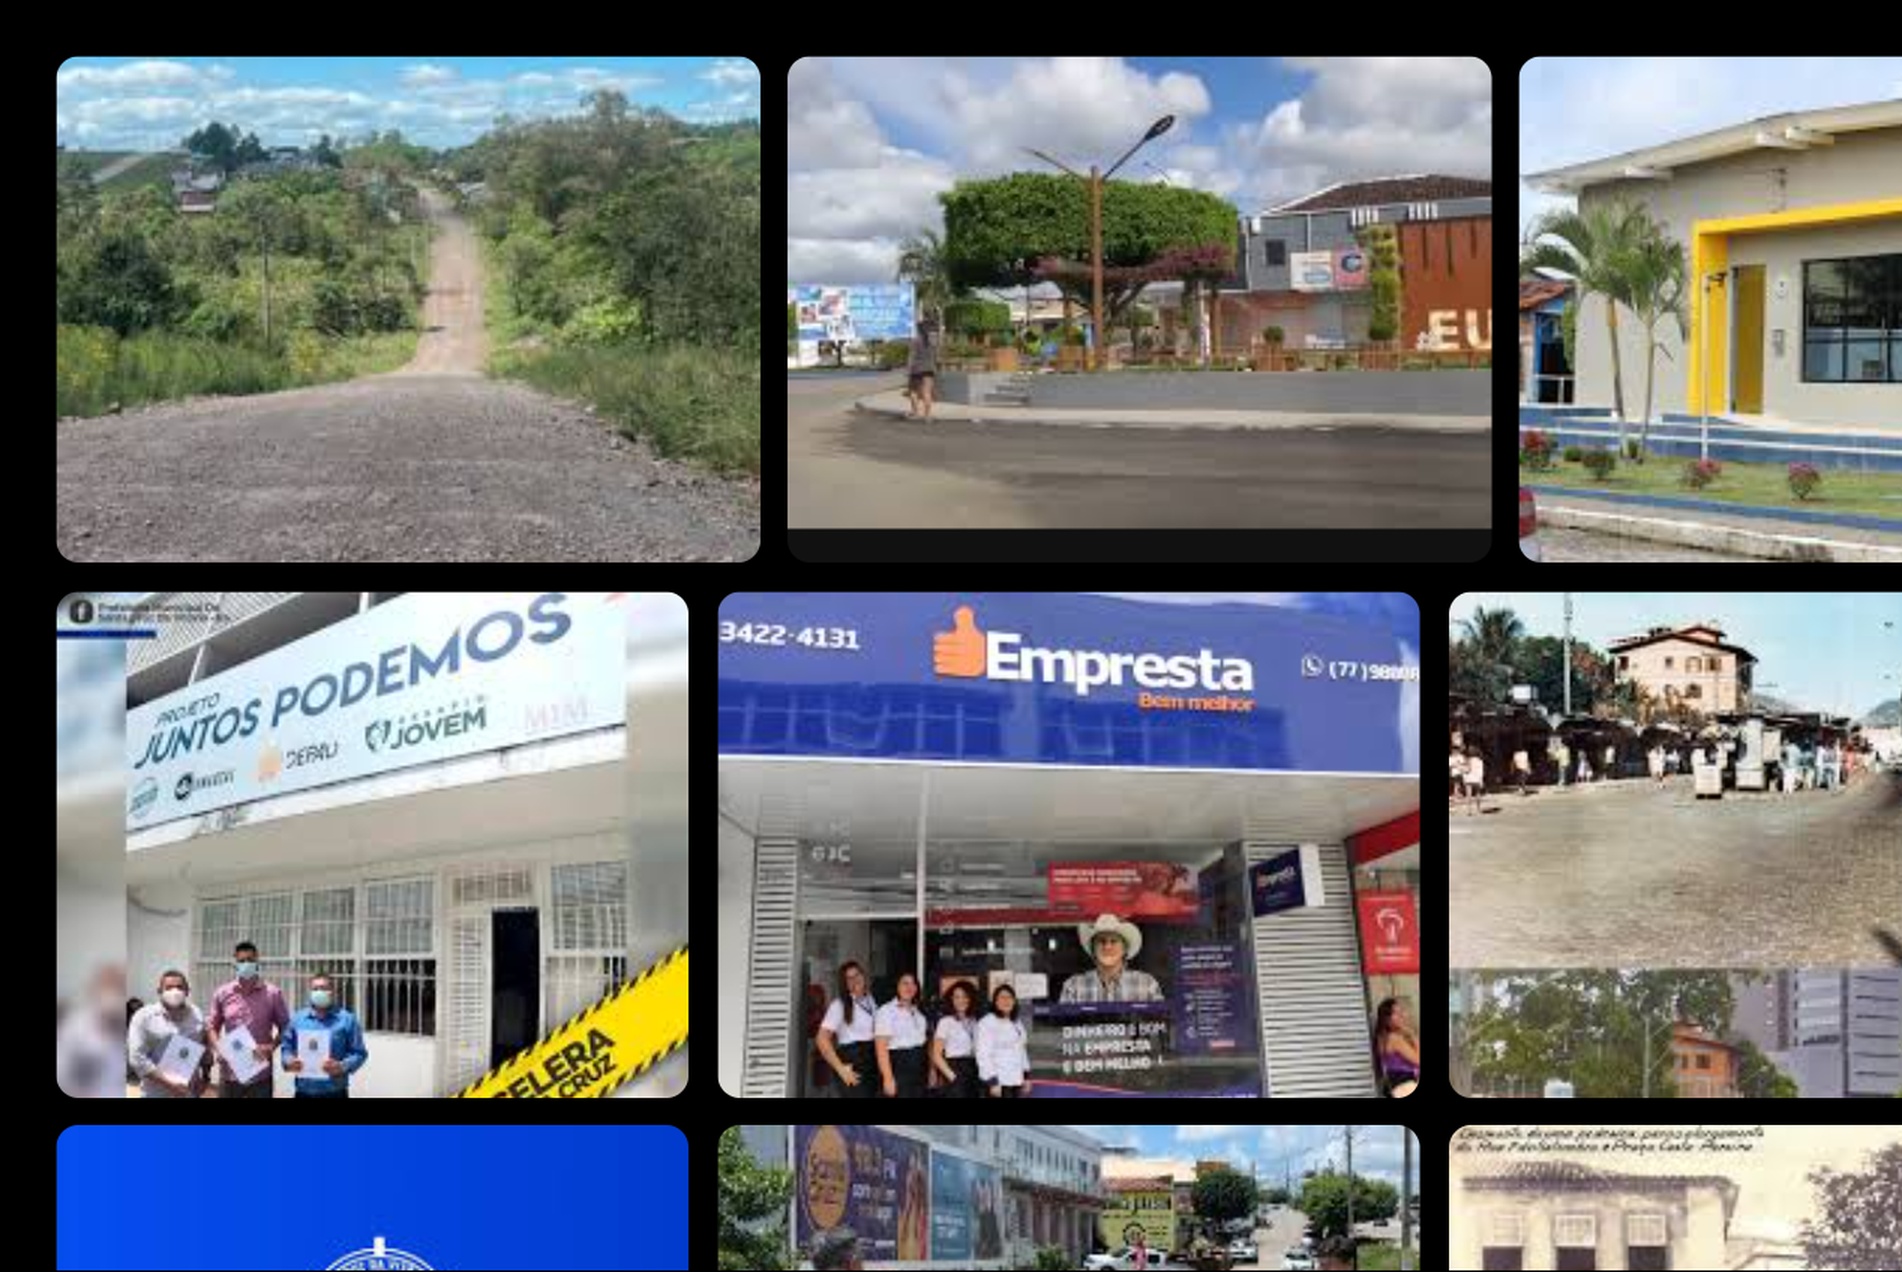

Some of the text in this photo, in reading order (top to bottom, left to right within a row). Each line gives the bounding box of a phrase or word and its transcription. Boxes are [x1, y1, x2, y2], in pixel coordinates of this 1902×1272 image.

[720, 621, 861, 651] 3422-4131
[986, 630, 1254, 696] Empresta
[134, 592, 572, 769] JUNTOS PODEMOS
[390, 705, 487, 750] JOVEM
